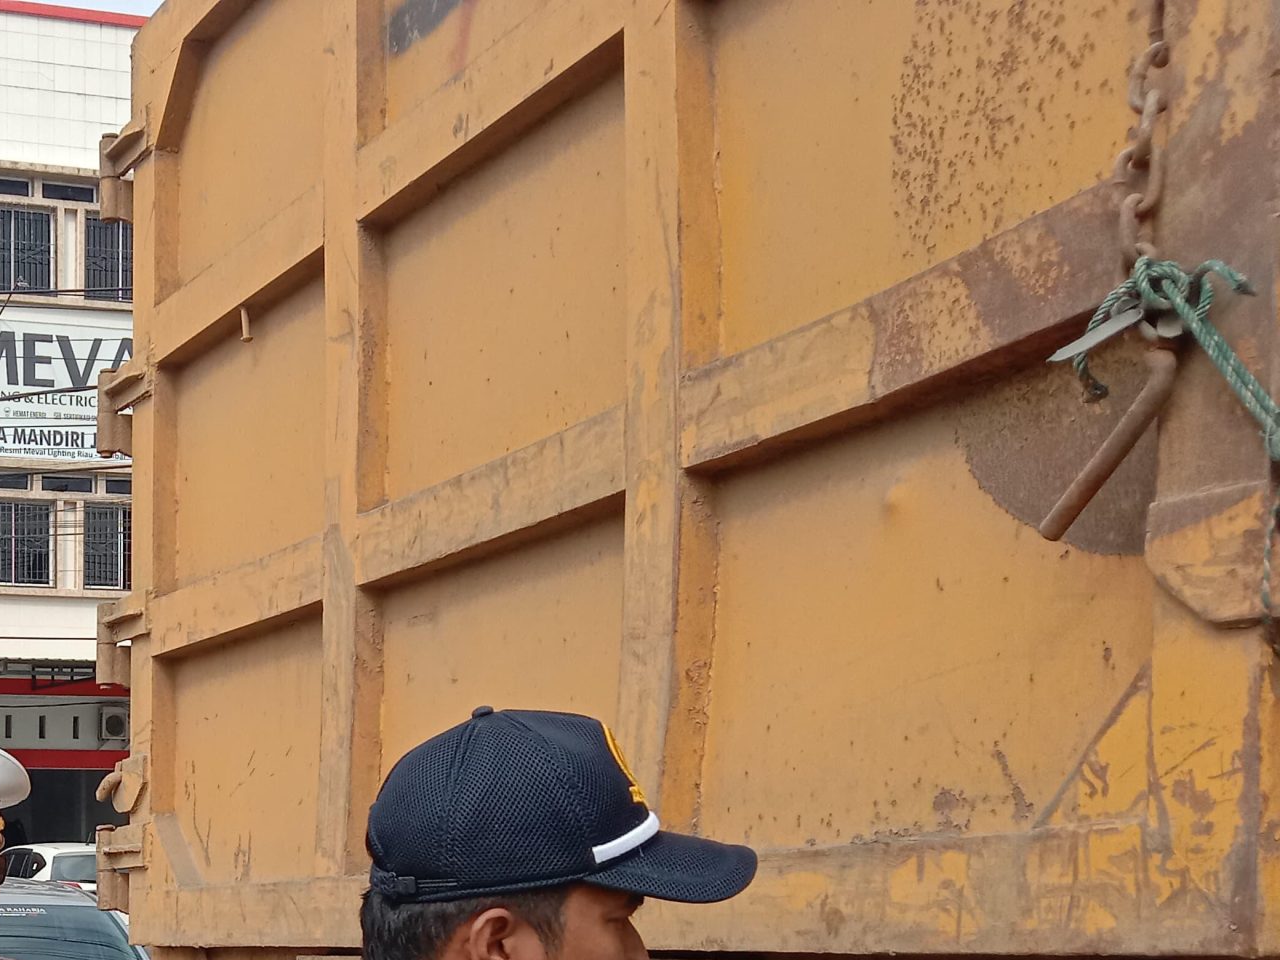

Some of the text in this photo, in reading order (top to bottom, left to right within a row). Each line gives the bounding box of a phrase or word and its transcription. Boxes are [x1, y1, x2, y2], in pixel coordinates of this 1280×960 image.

[36, 393, 97, 408] ELECTRIC
[12, 428, 85, 448] MANDIRI
[0, 446, 22, 454] Resmi
[47, 447, 77, 458] Lighting
[77, 450, 93, 458] Riau
